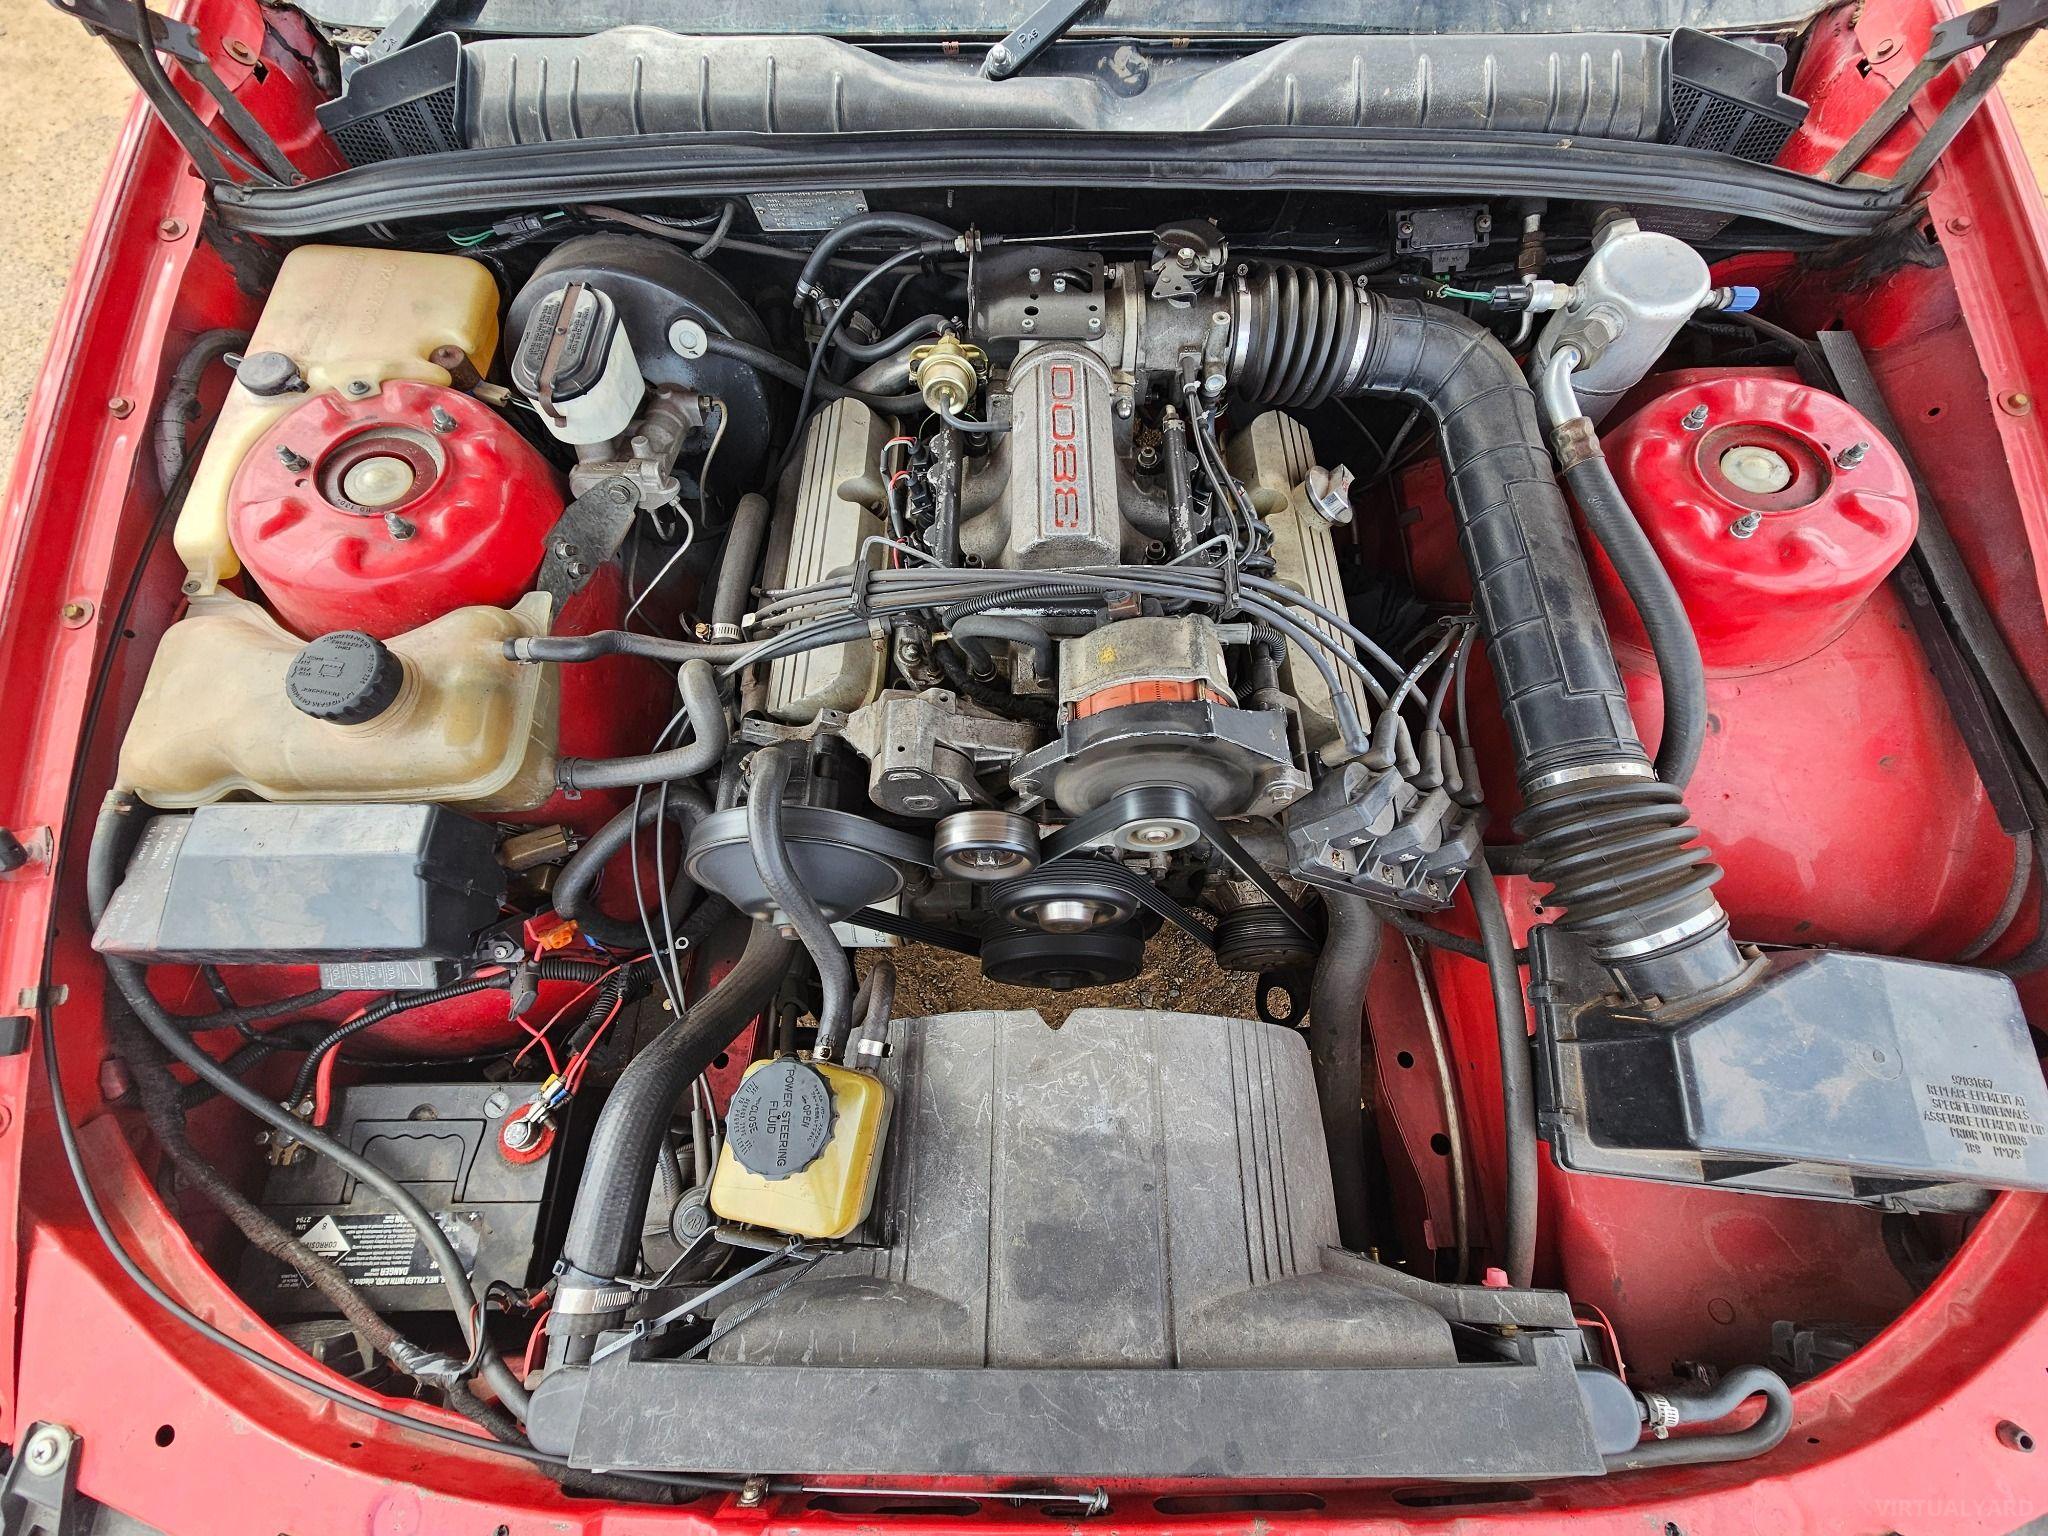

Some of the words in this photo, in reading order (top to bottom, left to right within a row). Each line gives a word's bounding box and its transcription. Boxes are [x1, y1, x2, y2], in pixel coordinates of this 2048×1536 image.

[1050, 363, 1080, 529] 3800
[783, 1068, 795, 1108] POWER
[1926, 1084, 1967, 1099] REPLACE
[1969, 1089, 2013, 1106] ELEMENT
[2015, 1095, 2026, 1107] AT
[748, 1104, 759, 1134] CLOSE
[767, 1100, 779, 1135] FLUID
[801, 1104, 811, 1128] OPEN
[1932, 1098, 1979, 1114] SPECIFIED
[1980, 1104, 2030, 1120] INTERVALS
[1923, 1110, 1974, 1126] ASSEMBLE
[1974, 1116, 2018, 1132] ELEMENT
[2030, 1123, 2046, 1136] LID
[1949, 1126, 1979, 1141] PRIOR
[1979, 1131, 1992, 1142] TO
[776, 1110, 791, 1167] STEERING
[295, 1216, 312, 1224] 2794
[304, 1241, 337, 1249] CORROSIV
[375, 1277, 390, 1286] ACID,
[380, 1266, 410, 1276] DANGER
[389, 1276, 405, 1285] WITH
[405, 1276, 426, 1285] FILLED
[425, 1276, 439, 1284] WET,
